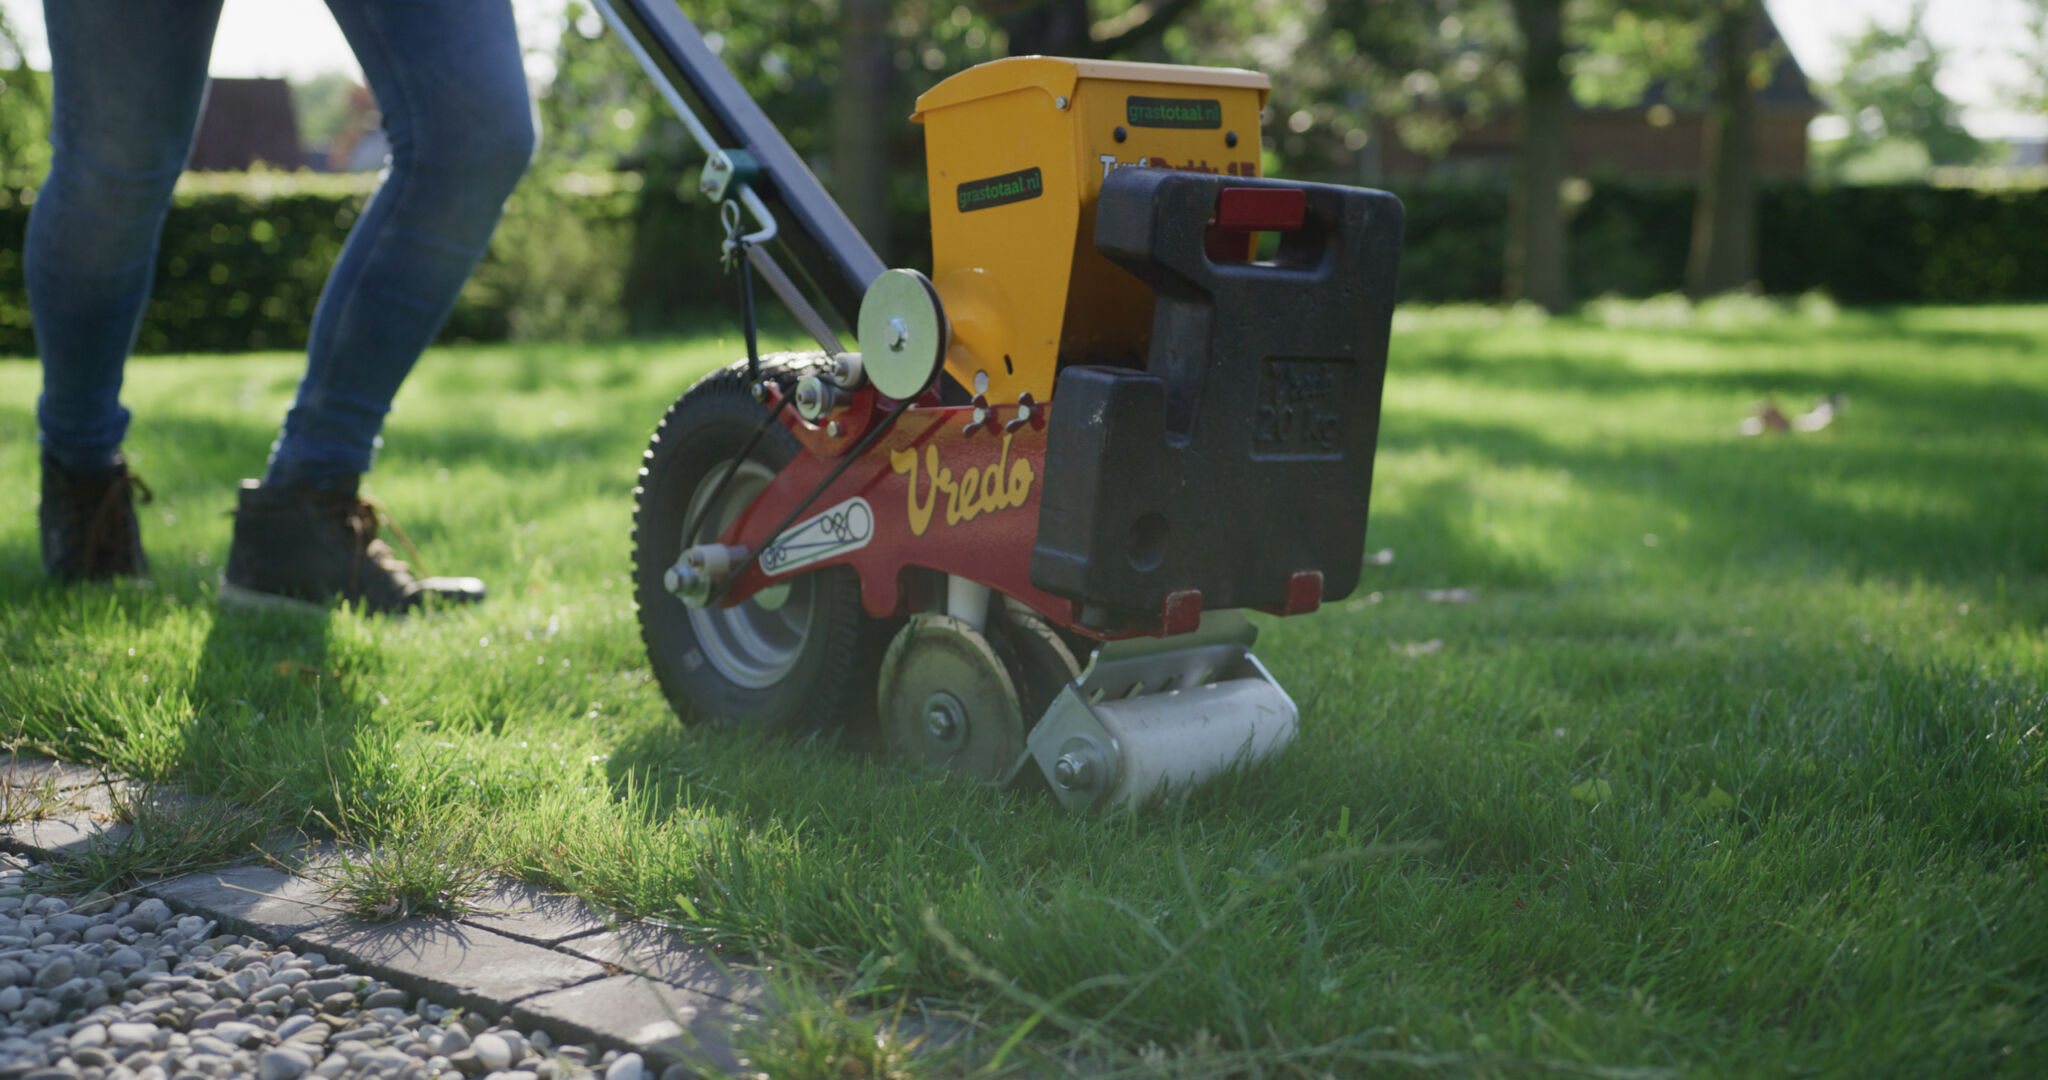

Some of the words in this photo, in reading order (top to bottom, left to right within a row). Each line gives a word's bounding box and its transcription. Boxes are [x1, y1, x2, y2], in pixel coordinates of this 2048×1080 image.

[1128, 104, 1220, 122] grastotaal.nl
[959, 172, 1041, 208] grastotaal.nl
[890, 433, 1035, 537] Vredo
